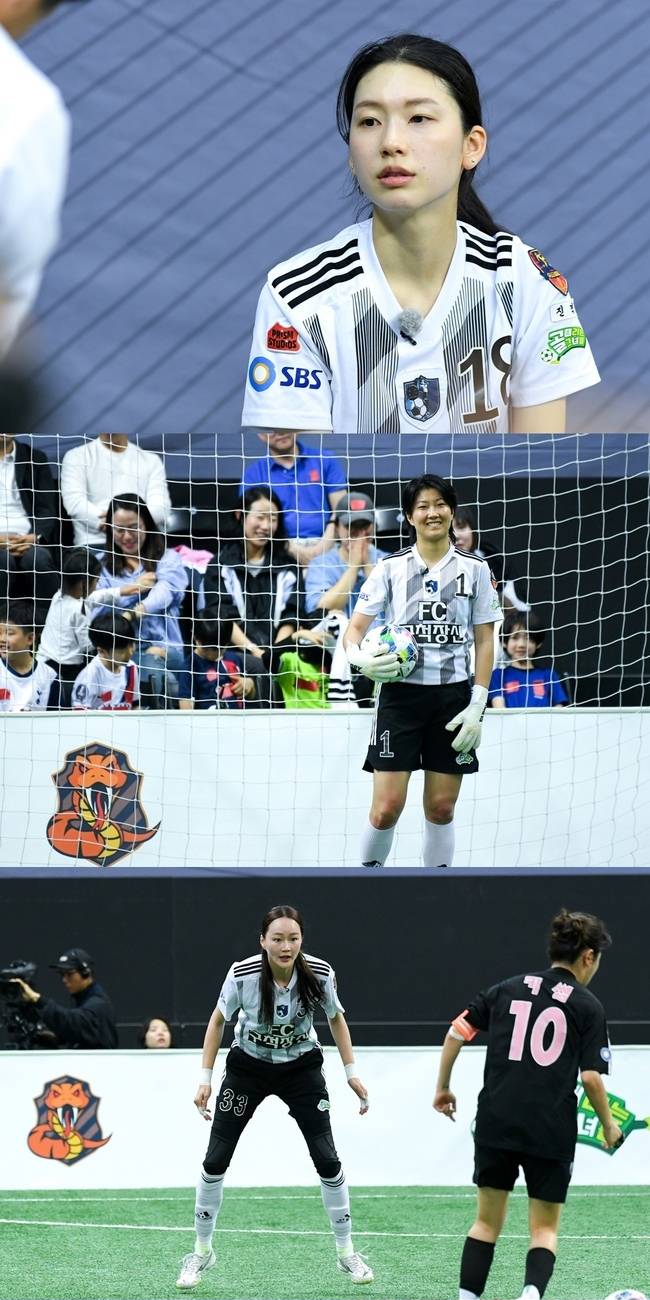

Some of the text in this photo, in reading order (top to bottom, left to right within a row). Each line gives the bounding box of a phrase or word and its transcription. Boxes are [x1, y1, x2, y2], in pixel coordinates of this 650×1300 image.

[267, 338, 297, 349] STUDIOS
[271, 329, 294, 340] PRISM
[279, 366, 323, 390] SBS
[455, 573, 469, 597] 1
[418, 601, 447, 621] FC
[379, 730, 394, 757] 1
[508, 1000, 567, 1067] 10
[219, 1088, 249, 1116] 33
